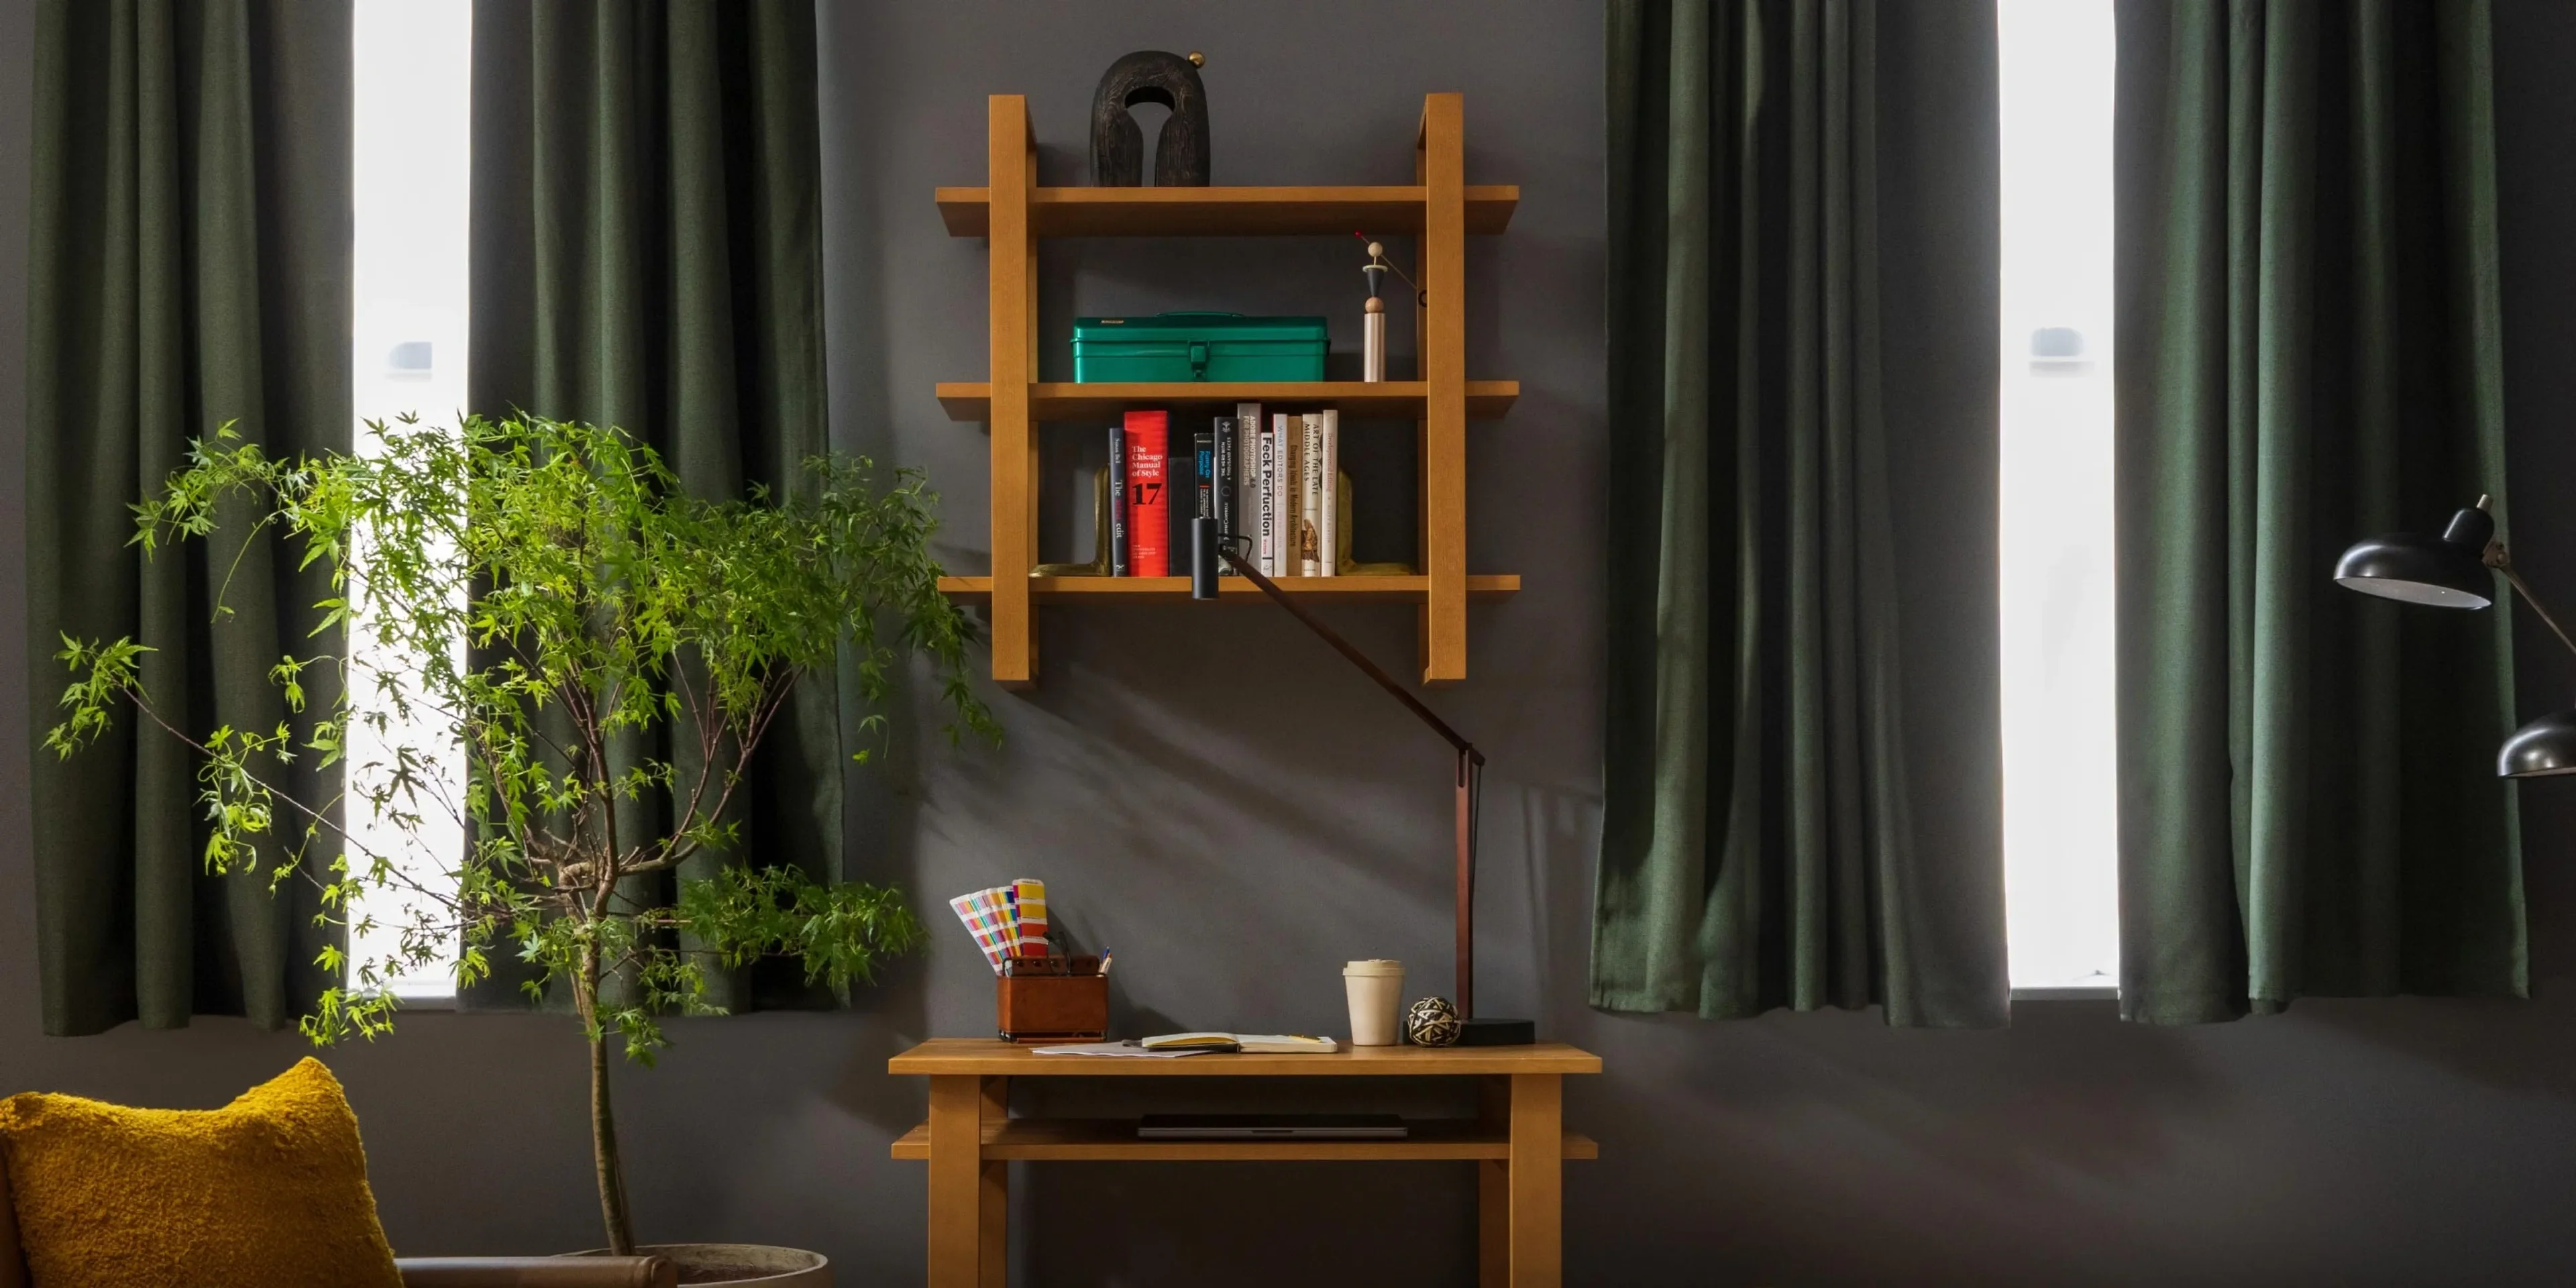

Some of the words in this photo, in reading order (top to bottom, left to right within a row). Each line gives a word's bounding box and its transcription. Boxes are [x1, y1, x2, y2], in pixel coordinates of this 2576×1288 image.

[1263, 437, 1272, 467] Feck
[1313, 443, 1320, 454] OF
[1132, 453, 1163, 462] Chicago
[1132, 469, 1141, 477] of
[1141, 469, 1159, 478] Style
[1205, 470, 1211, 478] On
[1115, 480, 1123, 496] The
[1132, 482, 1162, 505] 17
[1277, 486, 1283, 497] DO
[1263, 470, 1272, 536] Perfuction
[1290, 494, 1298, 513] Modern
[1116, 523, 1124, 539] edit
[1290, 515, 1299, 547] Architecture
